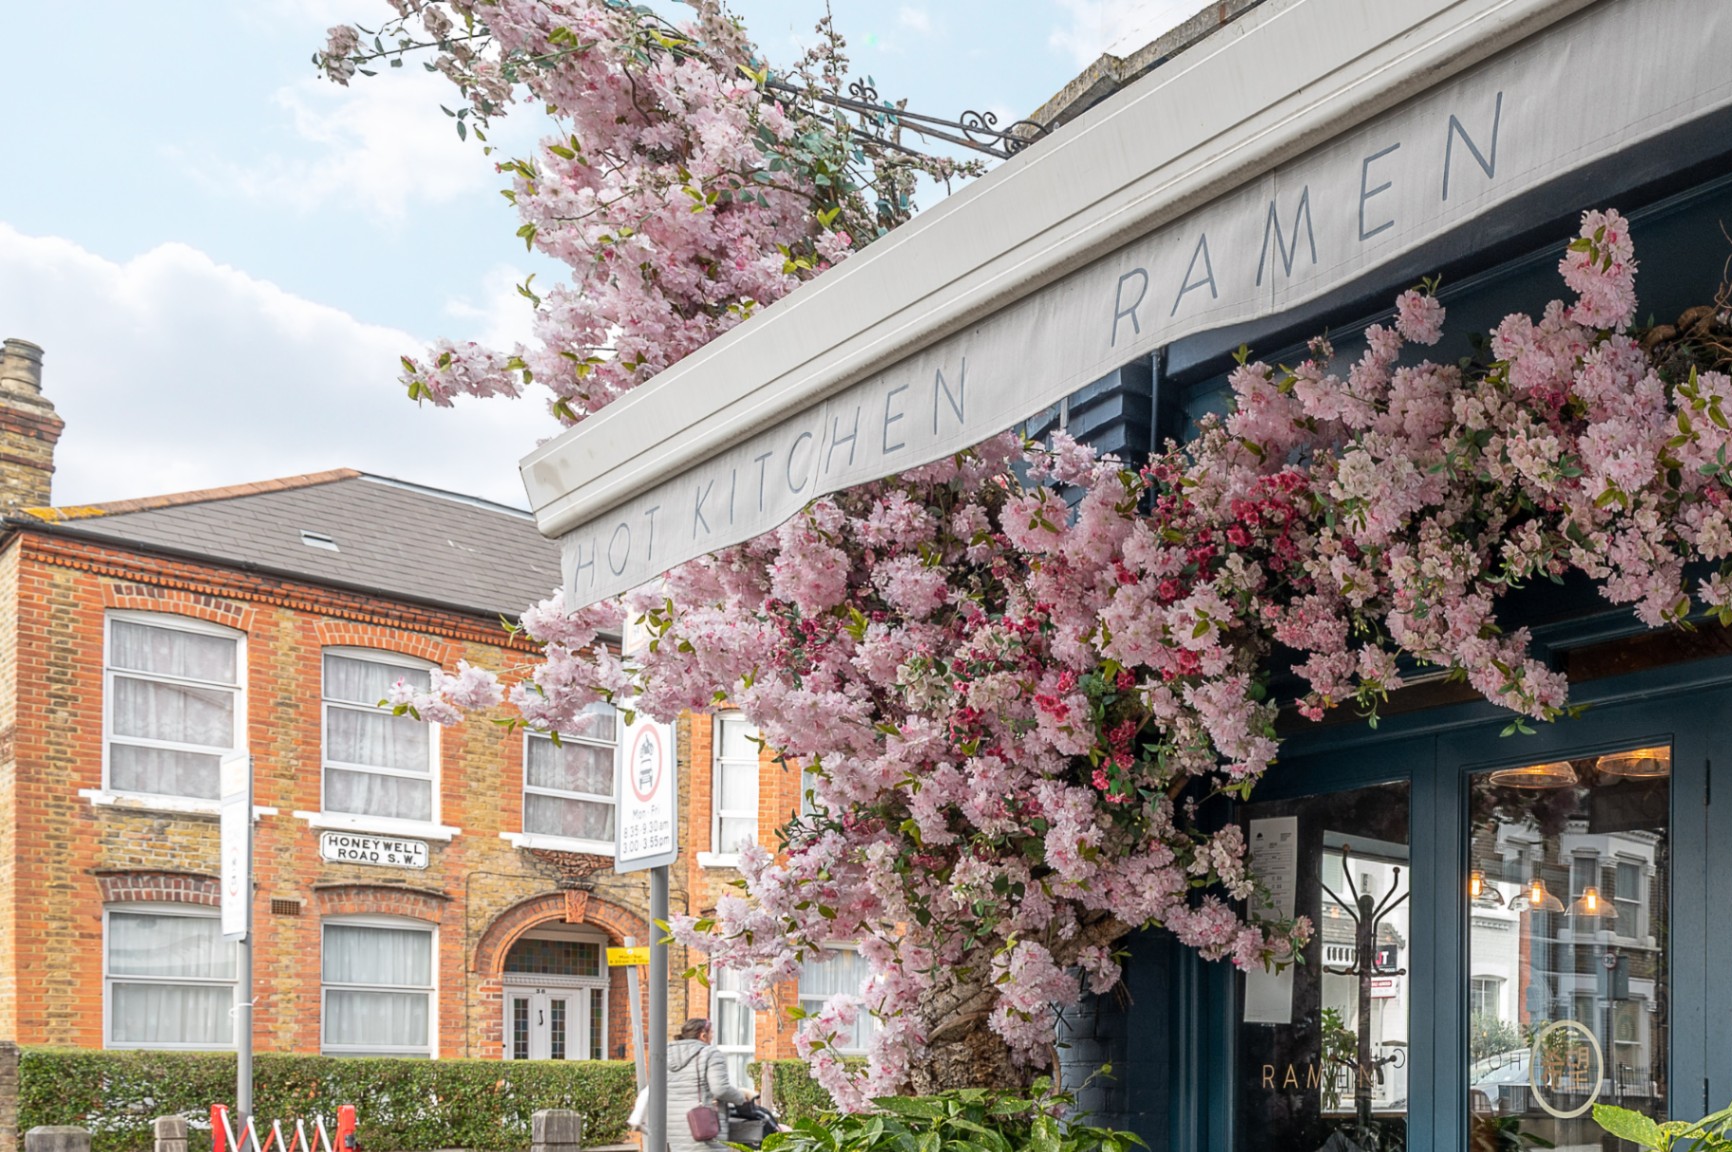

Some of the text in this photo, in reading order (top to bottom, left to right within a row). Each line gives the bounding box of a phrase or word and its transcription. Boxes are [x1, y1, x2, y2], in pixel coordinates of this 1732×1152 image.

[574, 90, 1503, 593] HOT KITCHEN RAMEN
[328, 835, 422, 855] HONEYWELL
[337, 848, 417, 865] ROAD S.W.
